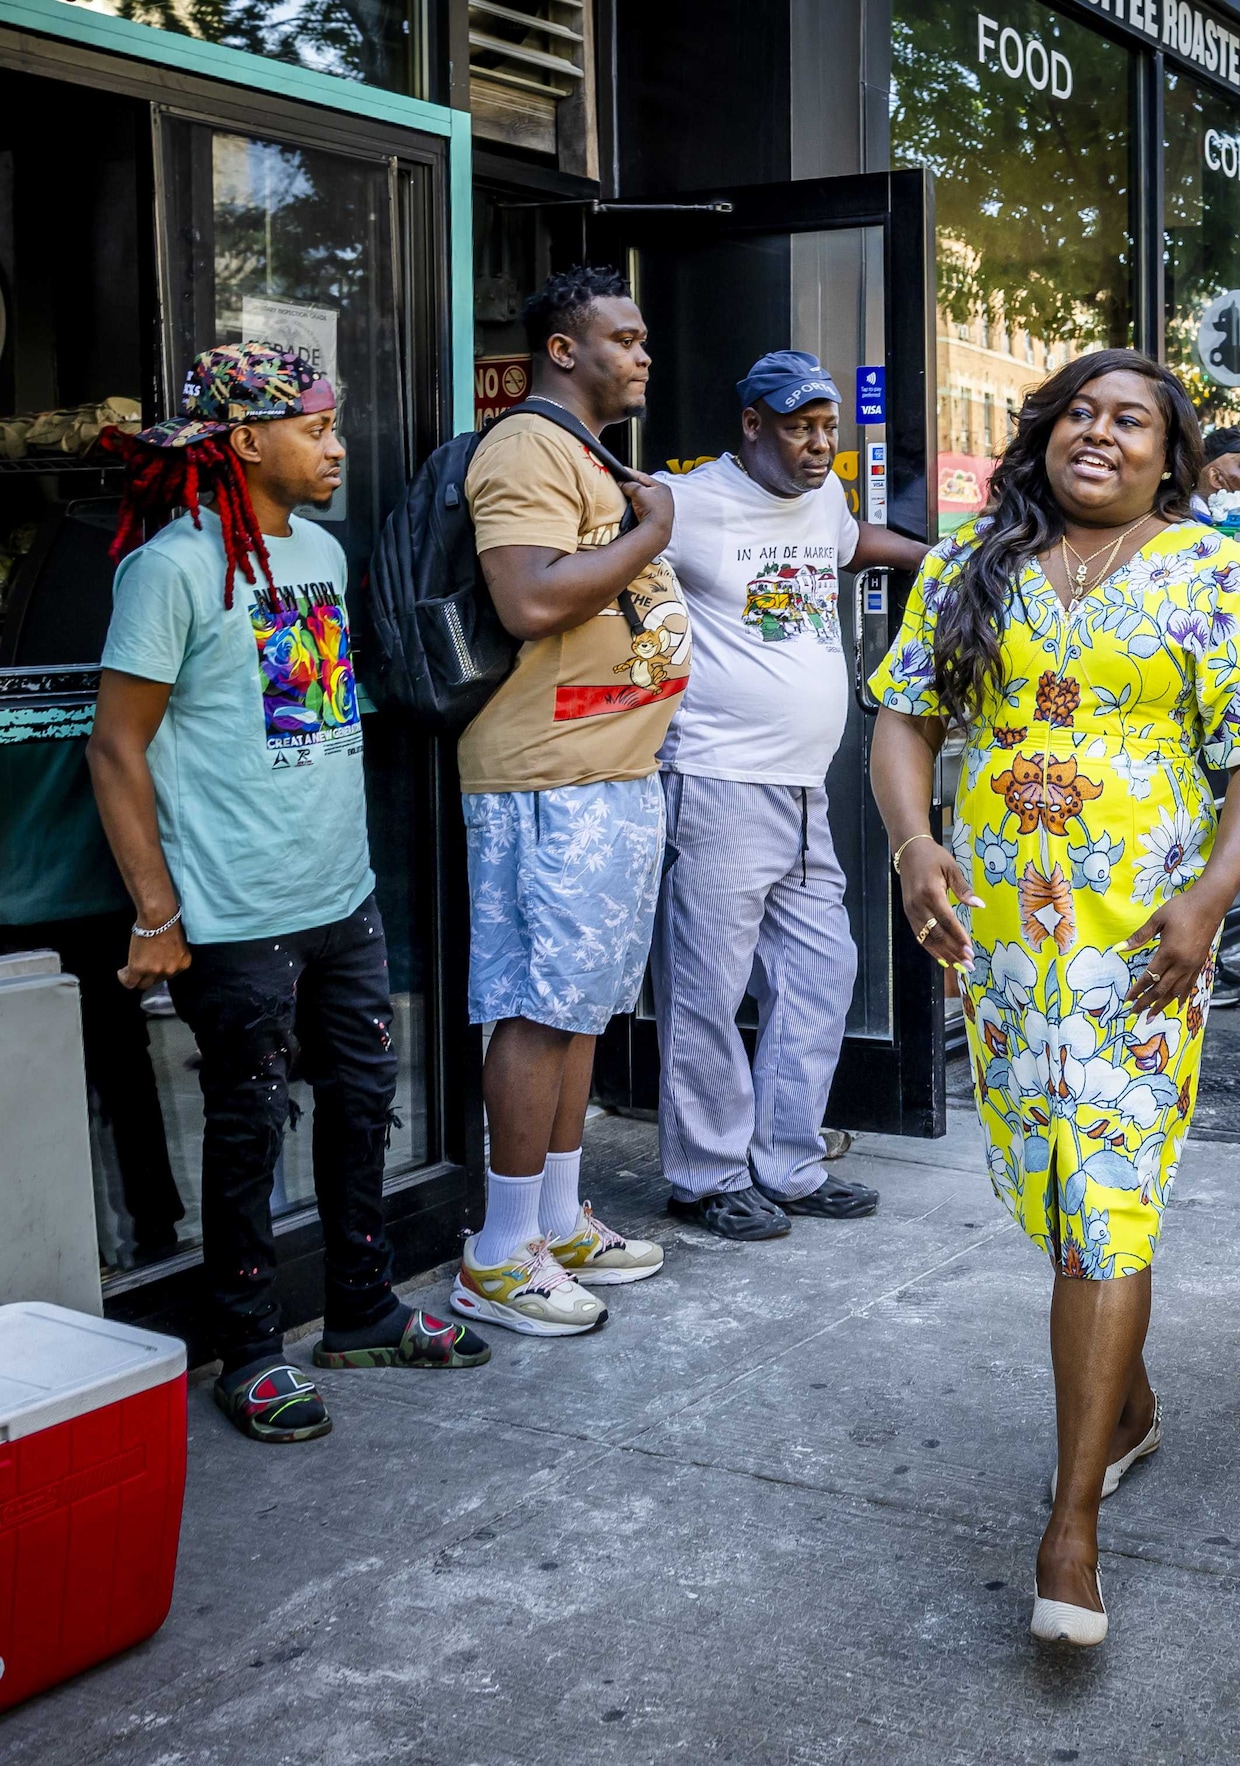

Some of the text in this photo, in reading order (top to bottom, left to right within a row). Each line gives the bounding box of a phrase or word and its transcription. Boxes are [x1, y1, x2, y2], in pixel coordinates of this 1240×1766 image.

[977, 13, 1073, 100] FOOD
[475, 367, 499, 399] NO
[860, 404, 882, 415] VISA
[737, 549, 752, 561] IN
[759, 546, 777, 559] AH
[783, 546, 798, 559] DE
[297, 581, 341, 609] YORK
[267, 735, 304, 750] CREAT
[312, 728, 334, 744] NEW
